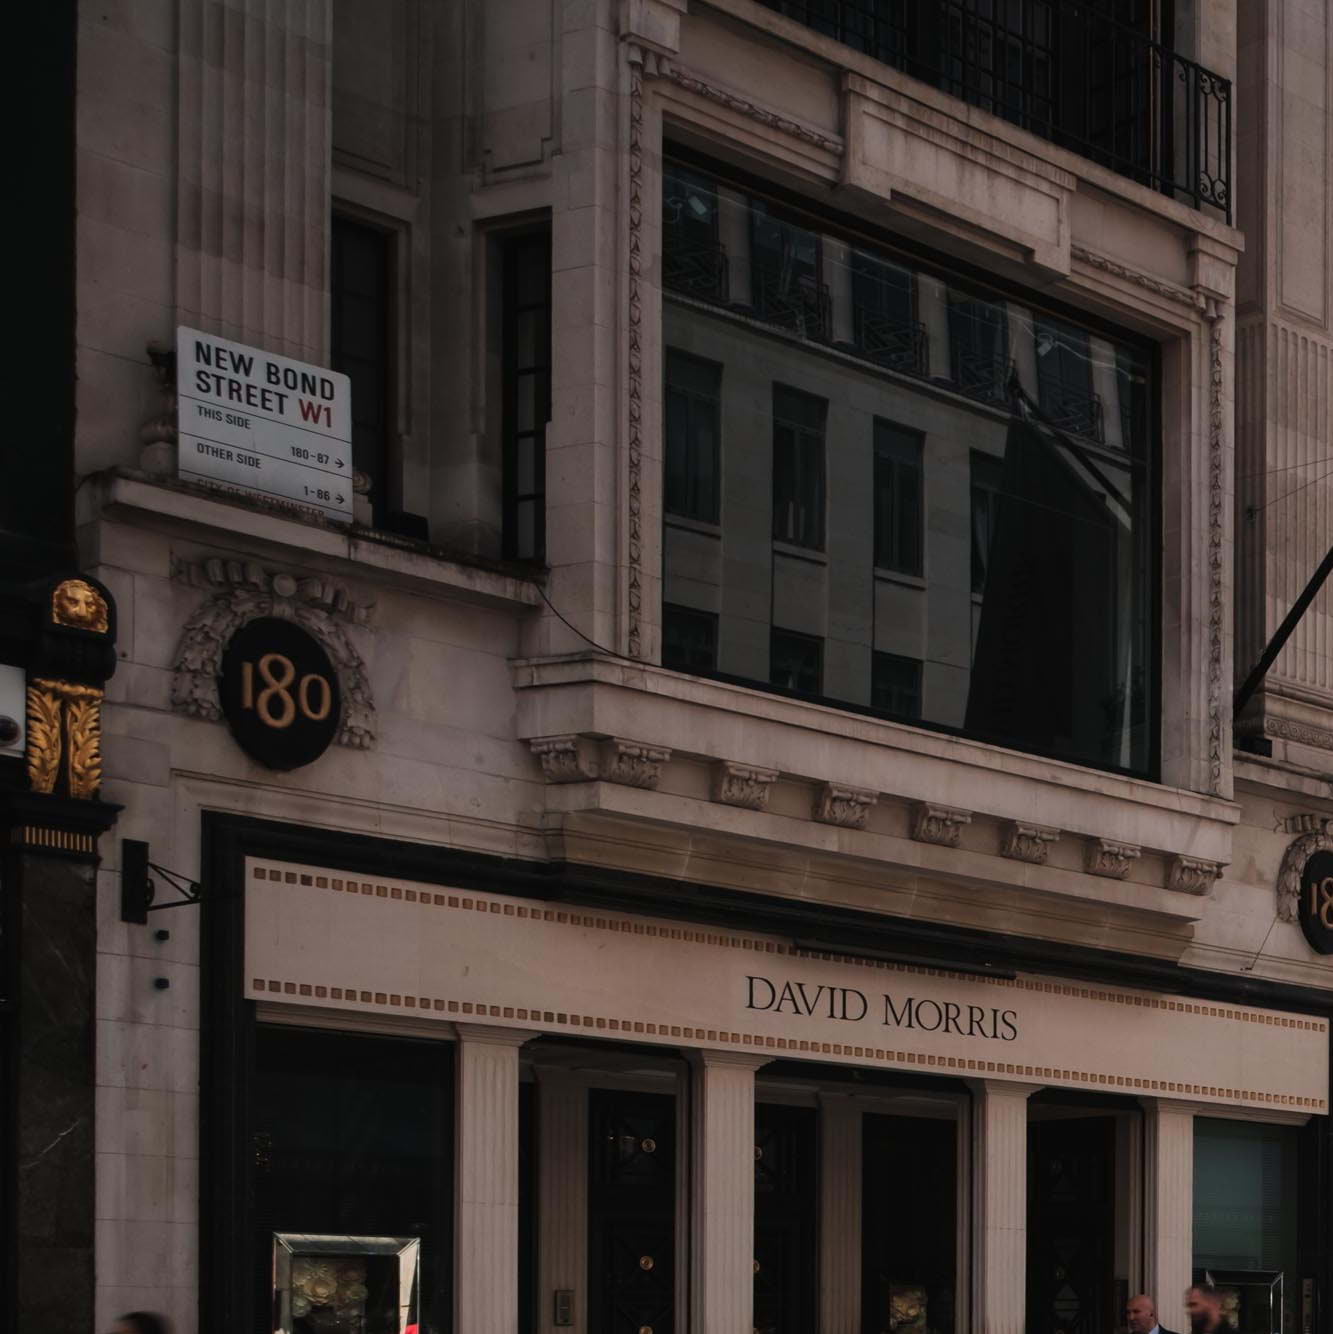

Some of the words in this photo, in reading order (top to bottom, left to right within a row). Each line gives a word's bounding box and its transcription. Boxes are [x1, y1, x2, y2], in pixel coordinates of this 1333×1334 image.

[195, 340, 254, 377] NEW
[266, 362, 335, 401] BOND
[196, 370, 288, 415] STREET
[299, 398, 332, 428] W1
[197, 405, 223, 422] THIS
[226, 414, 251, 430] SIDE
[197, 443, 233, 462] OTHER
[236, 453, 262, 469] SIDE
[291, 446, 330, 465] 180-87
[304, 486, 330, 501] 1-86
[241, 652, 332, 729] 180
[745, 975, 868, 1022] DAVID
[882, 994, 1017, 1041] MORRIS
